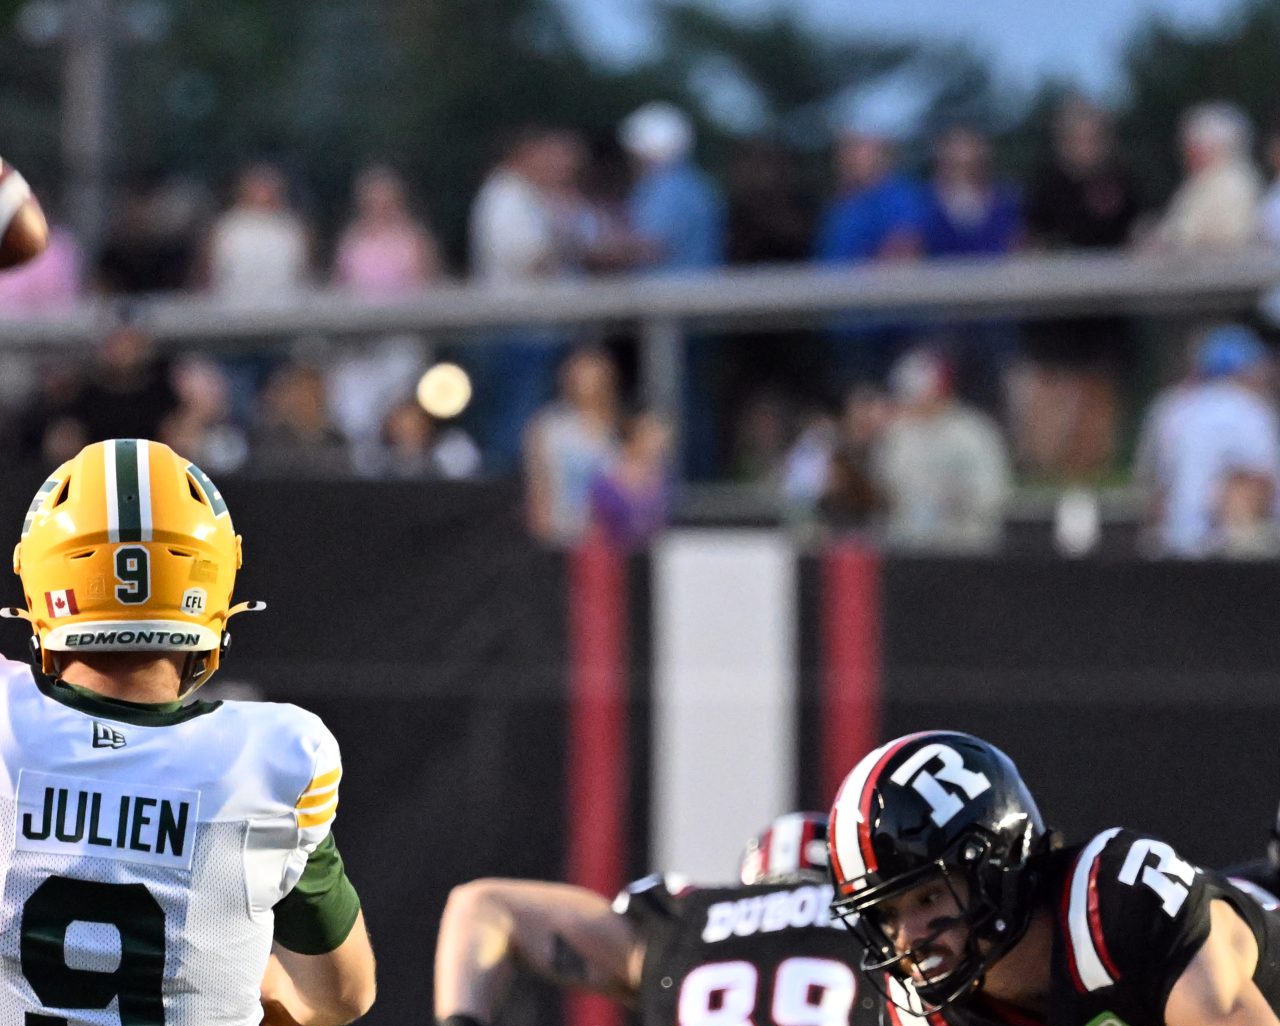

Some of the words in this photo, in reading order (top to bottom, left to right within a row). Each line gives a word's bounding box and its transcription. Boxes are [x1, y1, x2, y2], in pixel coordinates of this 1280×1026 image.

[113, 544, 152, 606] 9
[185, 596, 202, 608] CFL
[65, 631, 201, 648] EDMONTON
[890, 743, 992, 828] R
[22, 787, 190, 857] JULIEN
[1117, 838, 1196, 918] R
